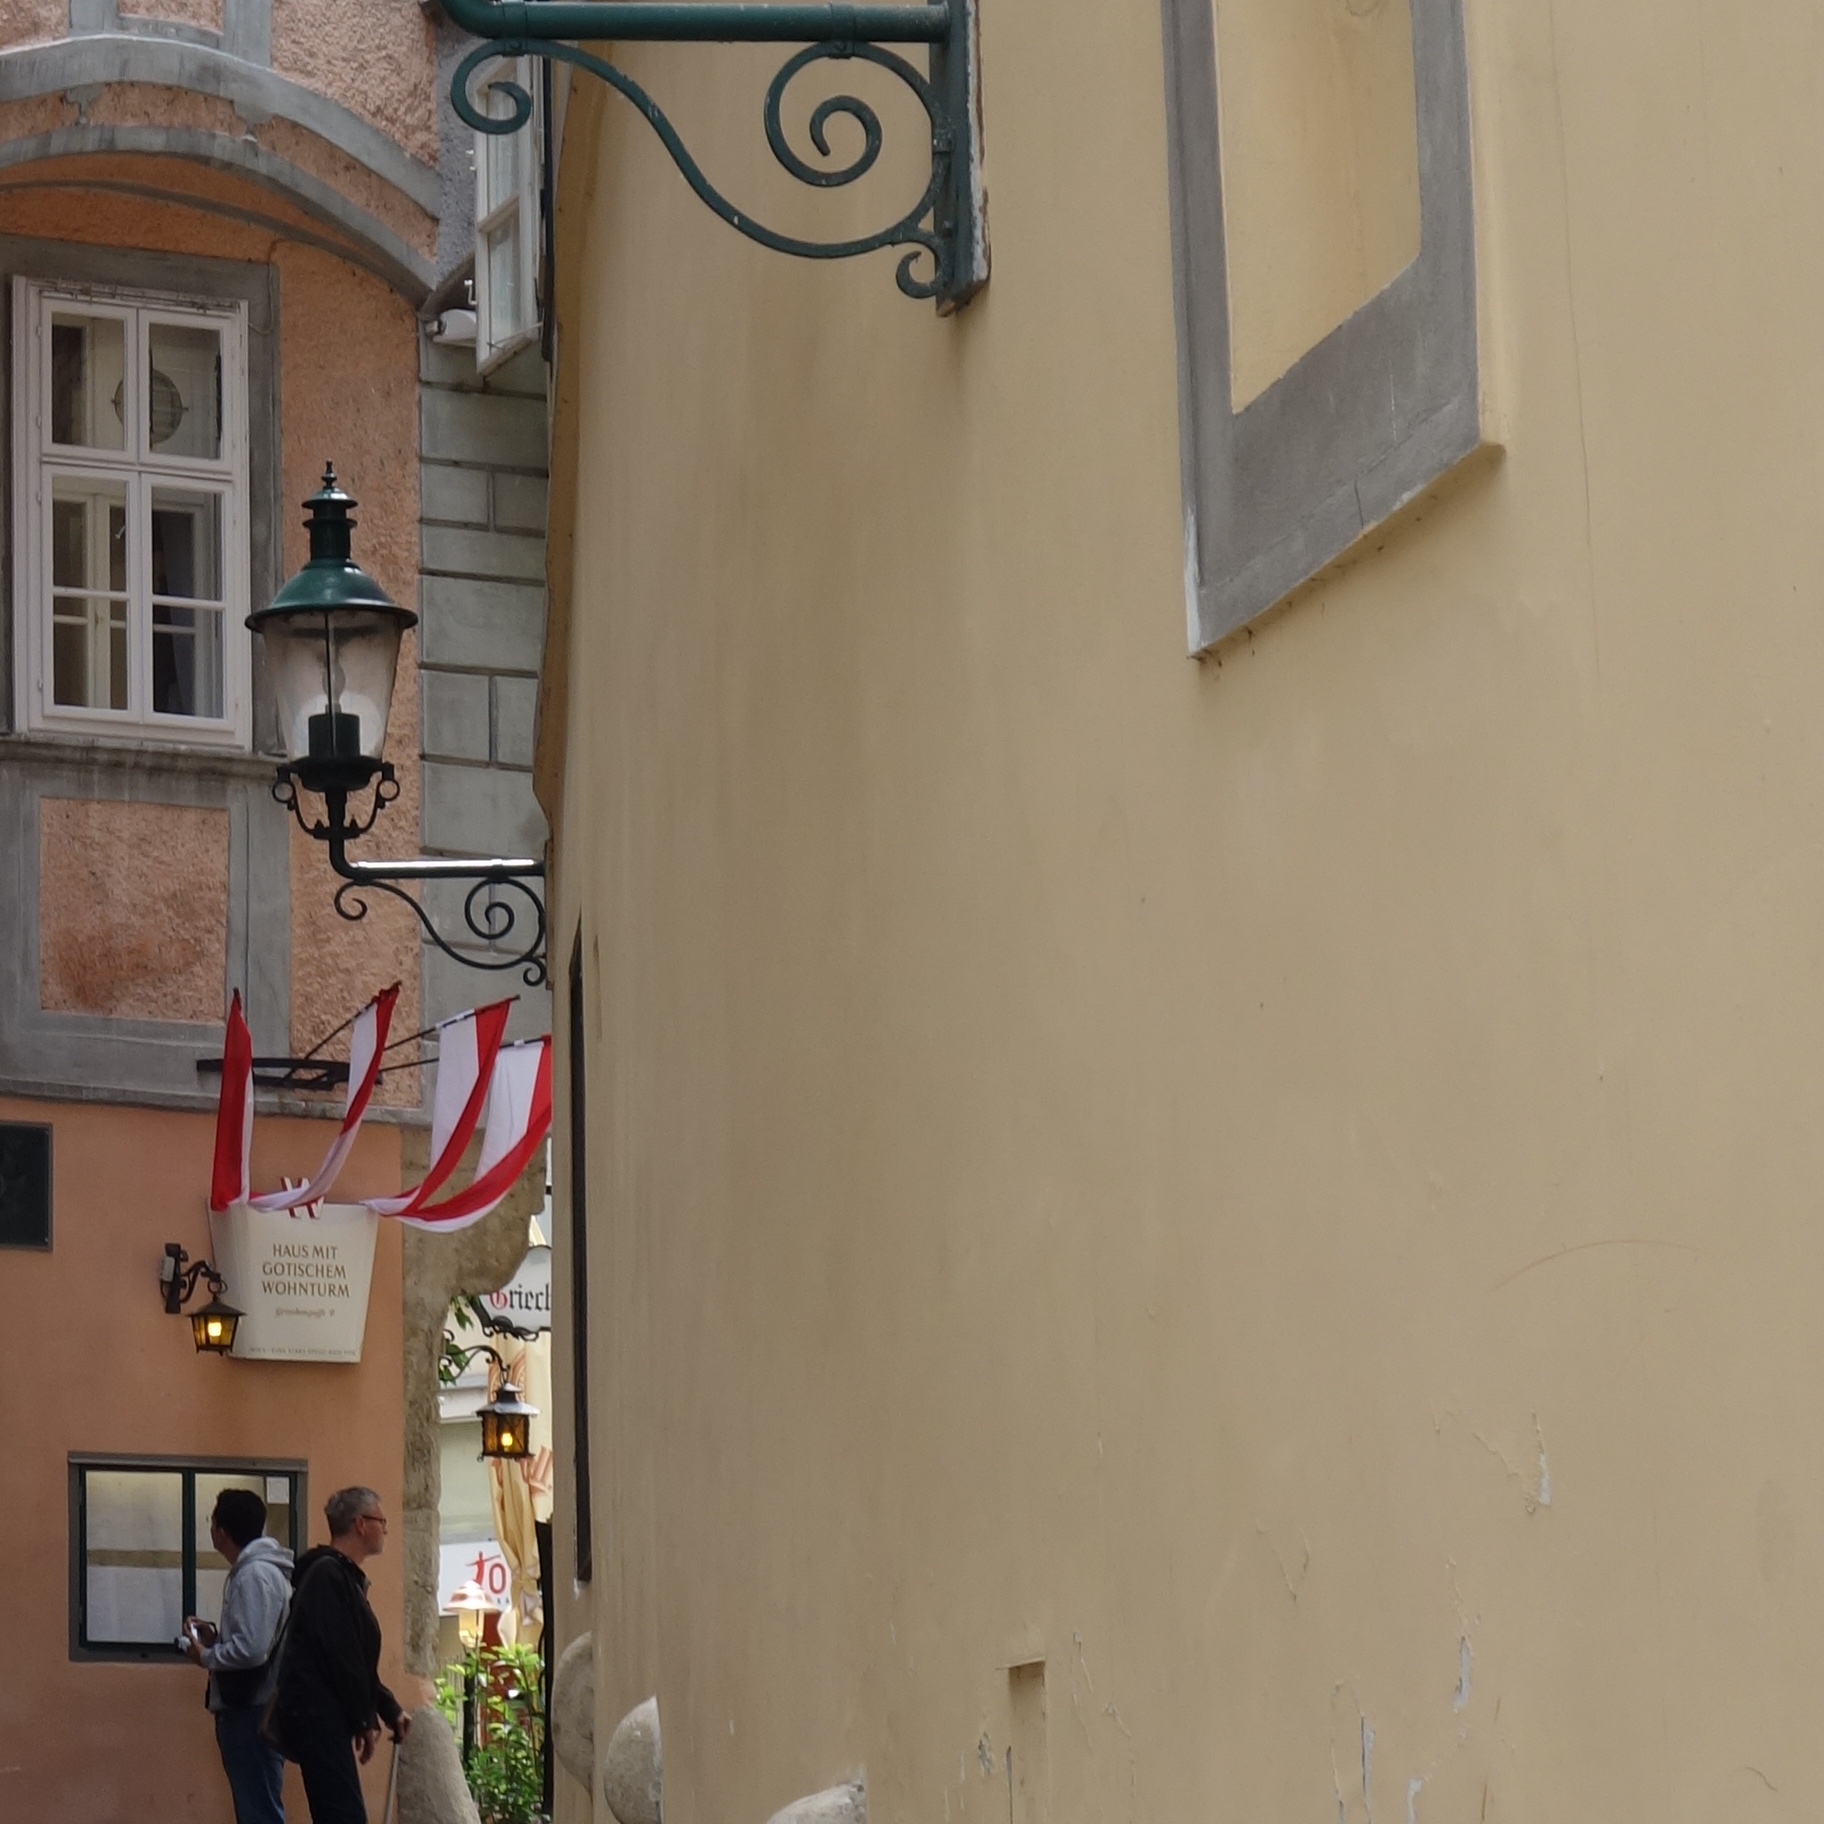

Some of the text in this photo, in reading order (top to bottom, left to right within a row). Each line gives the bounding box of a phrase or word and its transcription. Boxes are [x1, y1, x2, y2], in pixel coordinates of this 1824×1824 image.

[273, 1242, 338, 1260] HAUS MIT
[262, 1261, 347, 1279] GOTISCHEM
[262, 1280, 350, 1298] WOHNTURM
